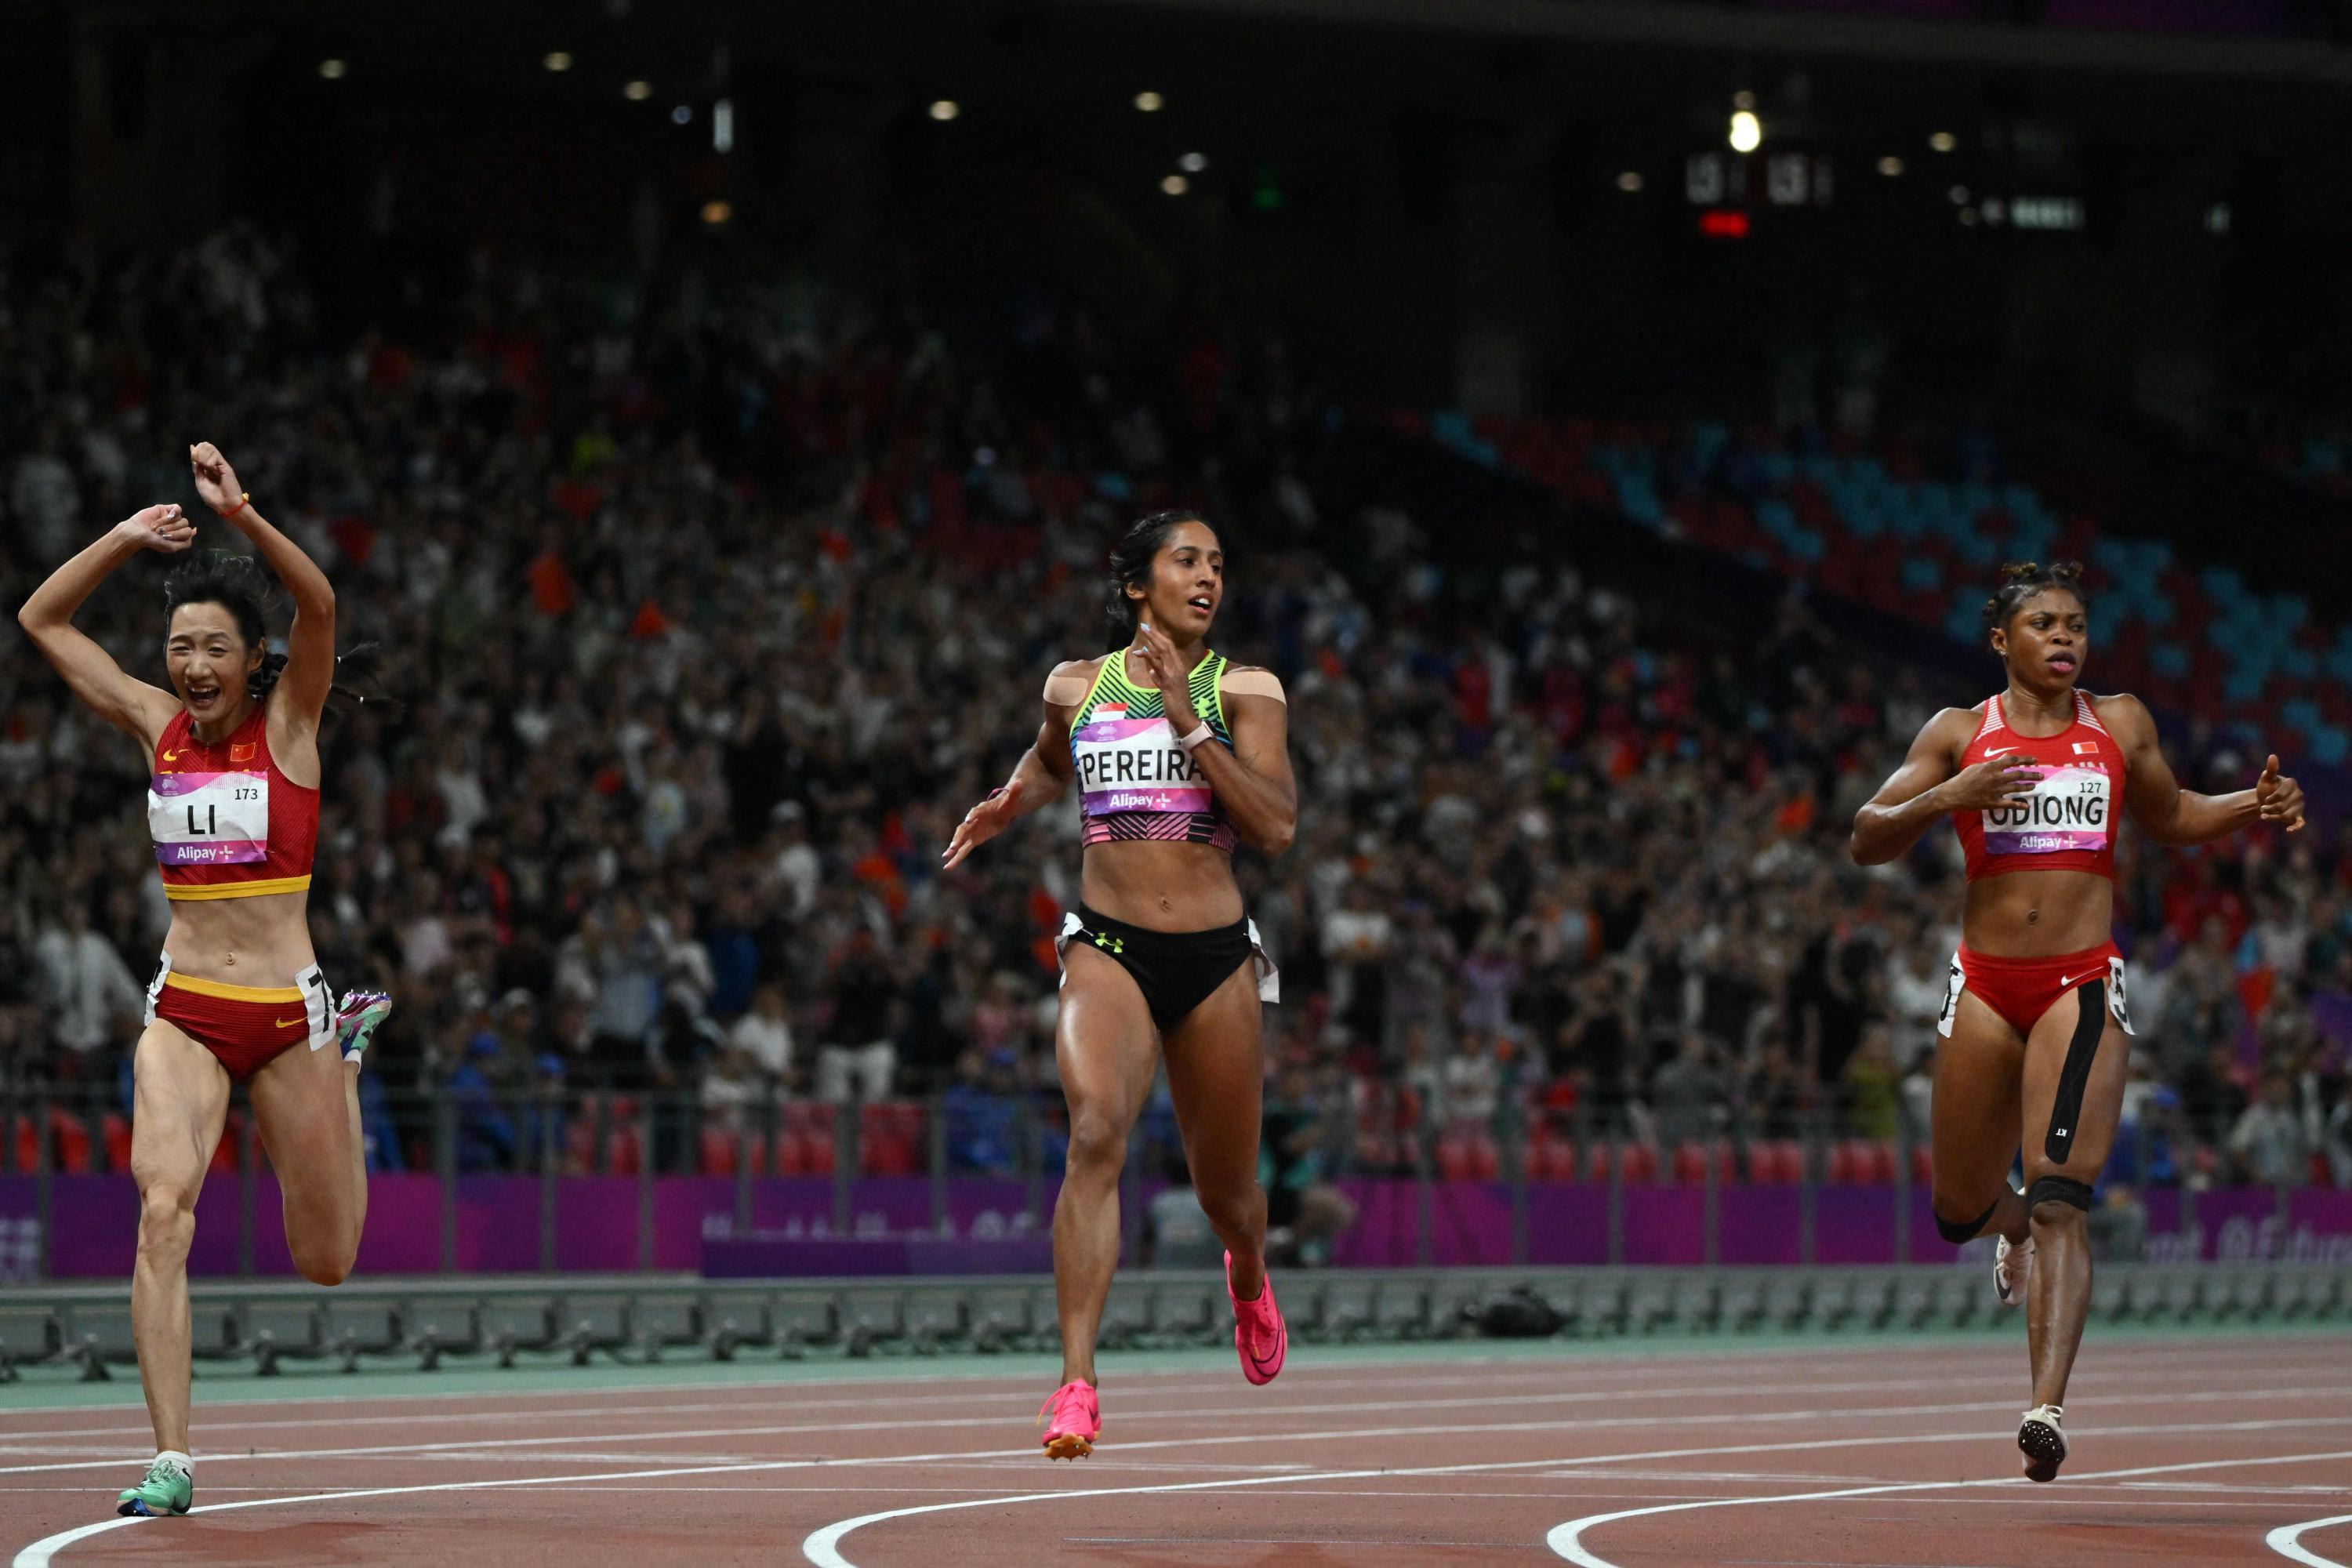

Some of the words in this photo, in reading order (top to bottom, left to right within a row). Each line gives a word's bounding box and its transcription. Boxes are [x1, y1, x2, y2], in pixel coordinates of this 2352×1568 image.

[1082, 749, 1207, 785] PEREIRA
[234, 789, 258, 800] 173
[2080, 782, 2101, 793] 127
[187, 804, 216, 835] LI
